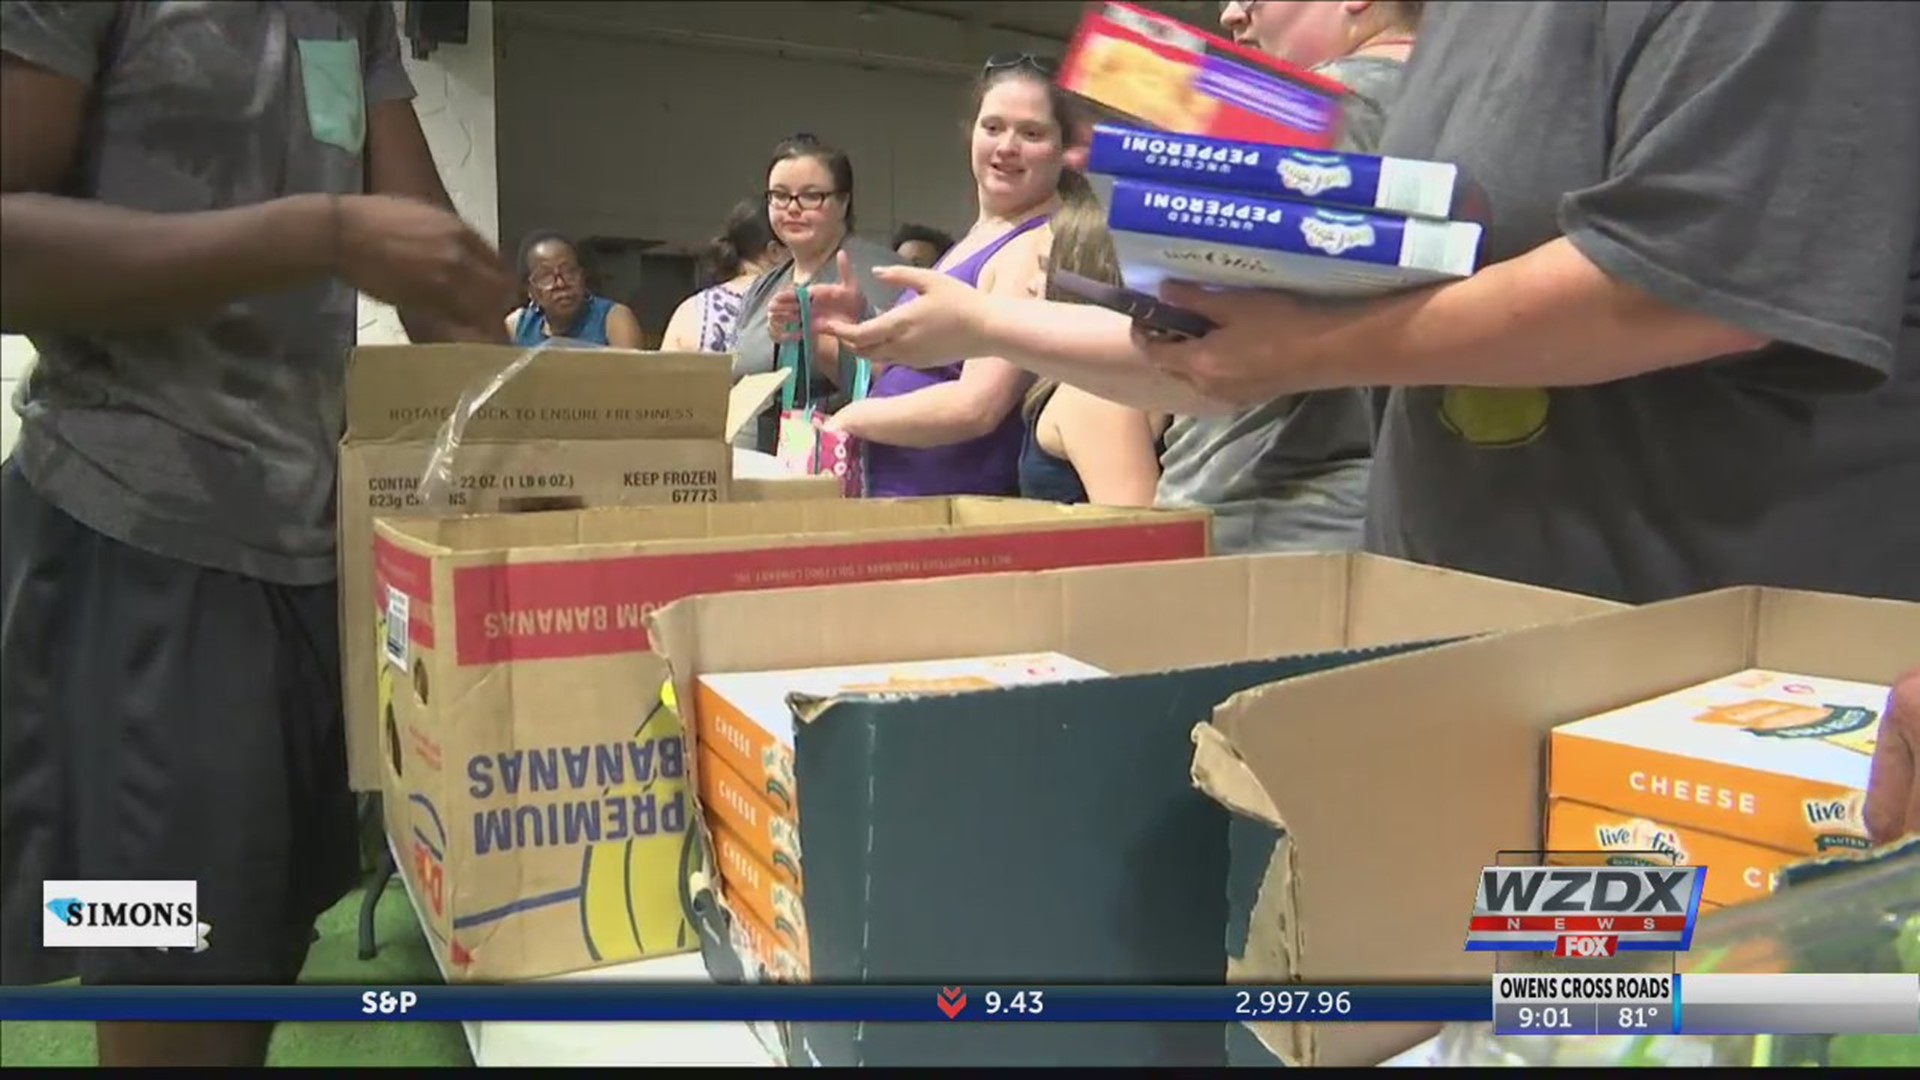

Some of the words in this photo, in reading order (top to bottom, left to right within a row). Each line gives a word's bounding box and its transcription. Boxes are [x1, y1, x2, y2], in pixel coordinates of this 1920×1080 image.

[1122, 136, 1260, 166] PEPPERONI
[1145, 154, 1232, 174] UNCURED
[1144, 191, 1283, 225] PEPPERONI
[1168, 210, 1254, 232] UNCURED
[389, 407, 450, 421] ROTATE
[516, 407, 536, 421] TO
[541, 407, 599, 421] ENSURE
[605, 406, 694, 421] FRESHNESS
[459, 475, 475, 489] 22
[623, 471, 660, 487] KEEP
[663, 469, 717, 486] FROZEN
[671, 488, 718, 504] 67773
[483, 604, 608, 639] BANANAS
[715, 714, 752, 759] CHEESE
[467, 736, 685, 799] BANANAS
[718, 779, 757, 828] CHEESE
[1629, 771, 1756, 814] CHEESE
[472, 791, 686, 855] PREMIUM
[1806, 801, 1846, 824] live
[1599, 828, 1631, 848] live
[722, 840, 760, 890] CHEESE
